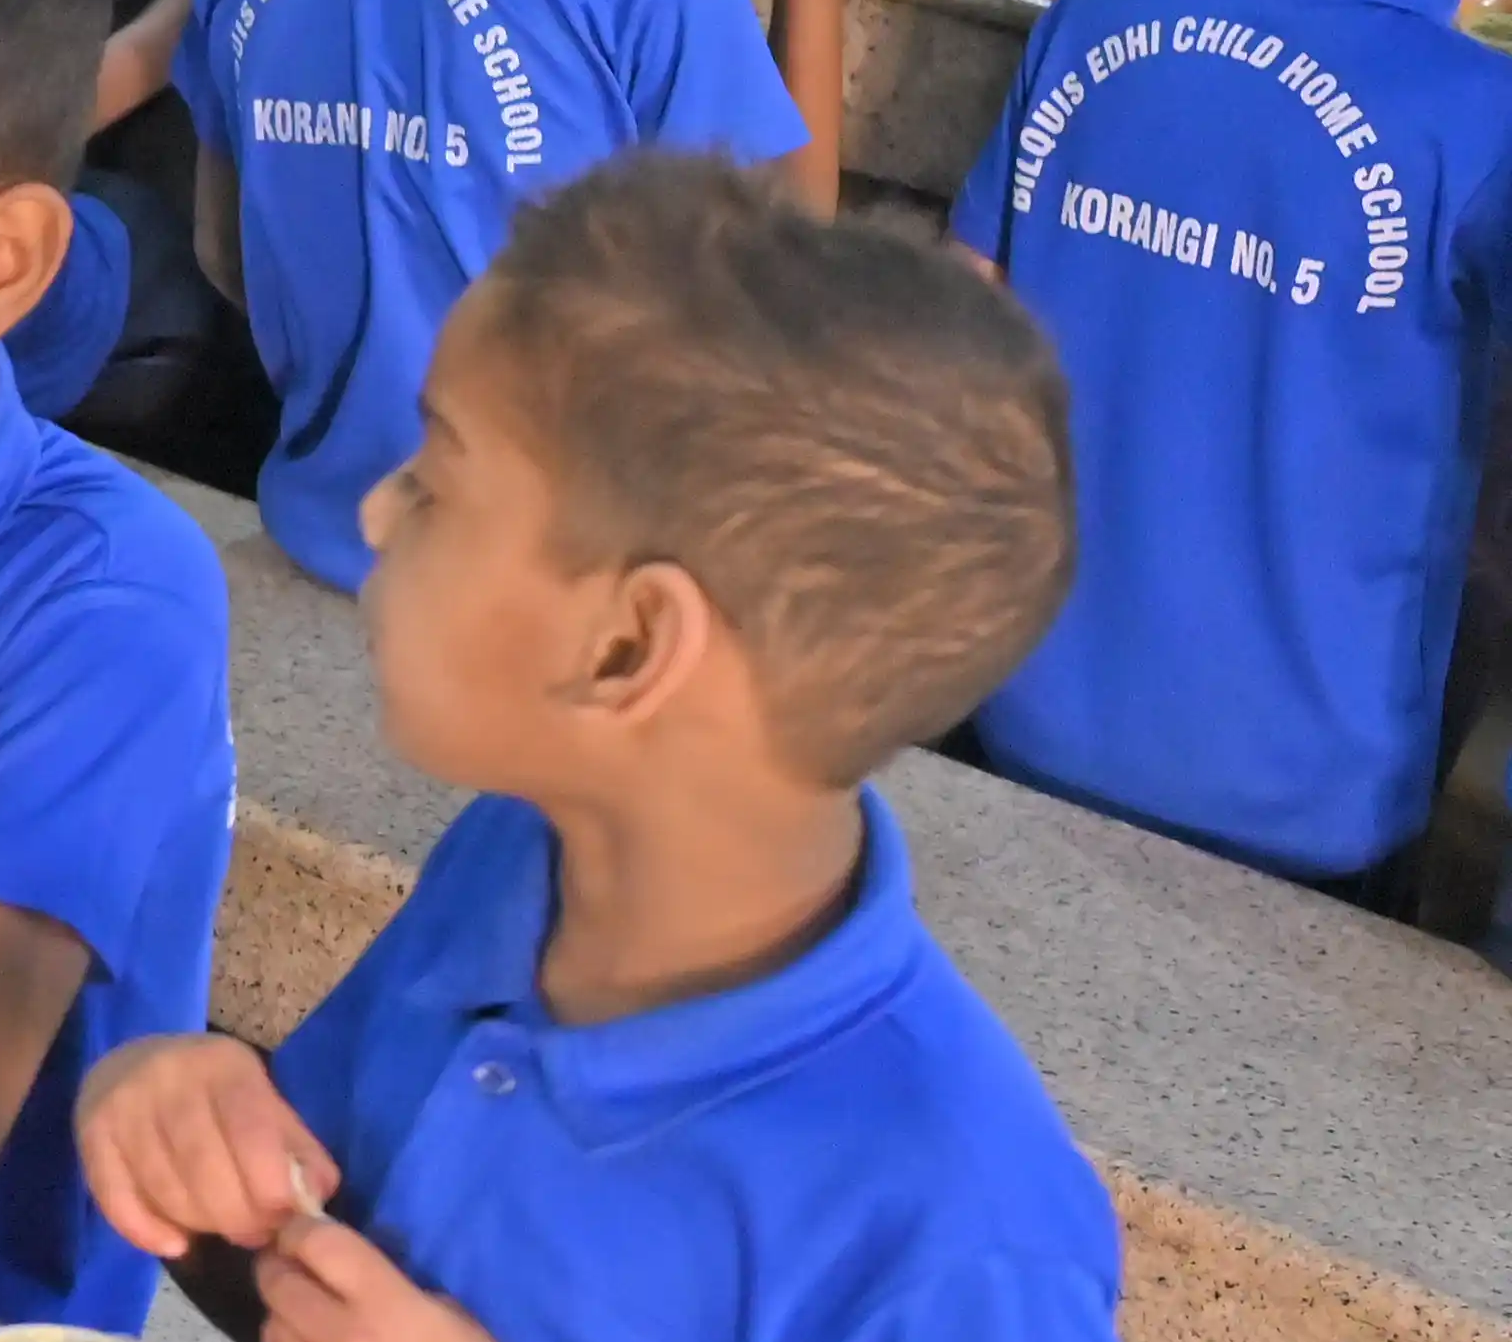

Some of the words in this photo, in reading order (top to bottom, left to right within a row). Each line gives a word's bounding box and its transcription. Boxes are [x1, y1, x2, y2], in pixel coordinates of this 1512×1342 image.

[253, 98, 372, 152] KORANI
[384, 110, 430, 163] NO.
[445, 123, 469, 167] 5
[473, 25, 543, 174] SCHOOL
[1012, 71, 1085, 213] BILQUIS
[1086, 20, 1161, 84] EDHI
[1172, 15, 1284, 70] CHILD
[1277, 52, 1378, 159] HOME
[1354, 162, 1409, 314] SCHOOL
[1060, 180, 1219, 269] KORANGI
[1230, 230, 1277, 293] NO.
[1290, 258, 1325, 305] 5
